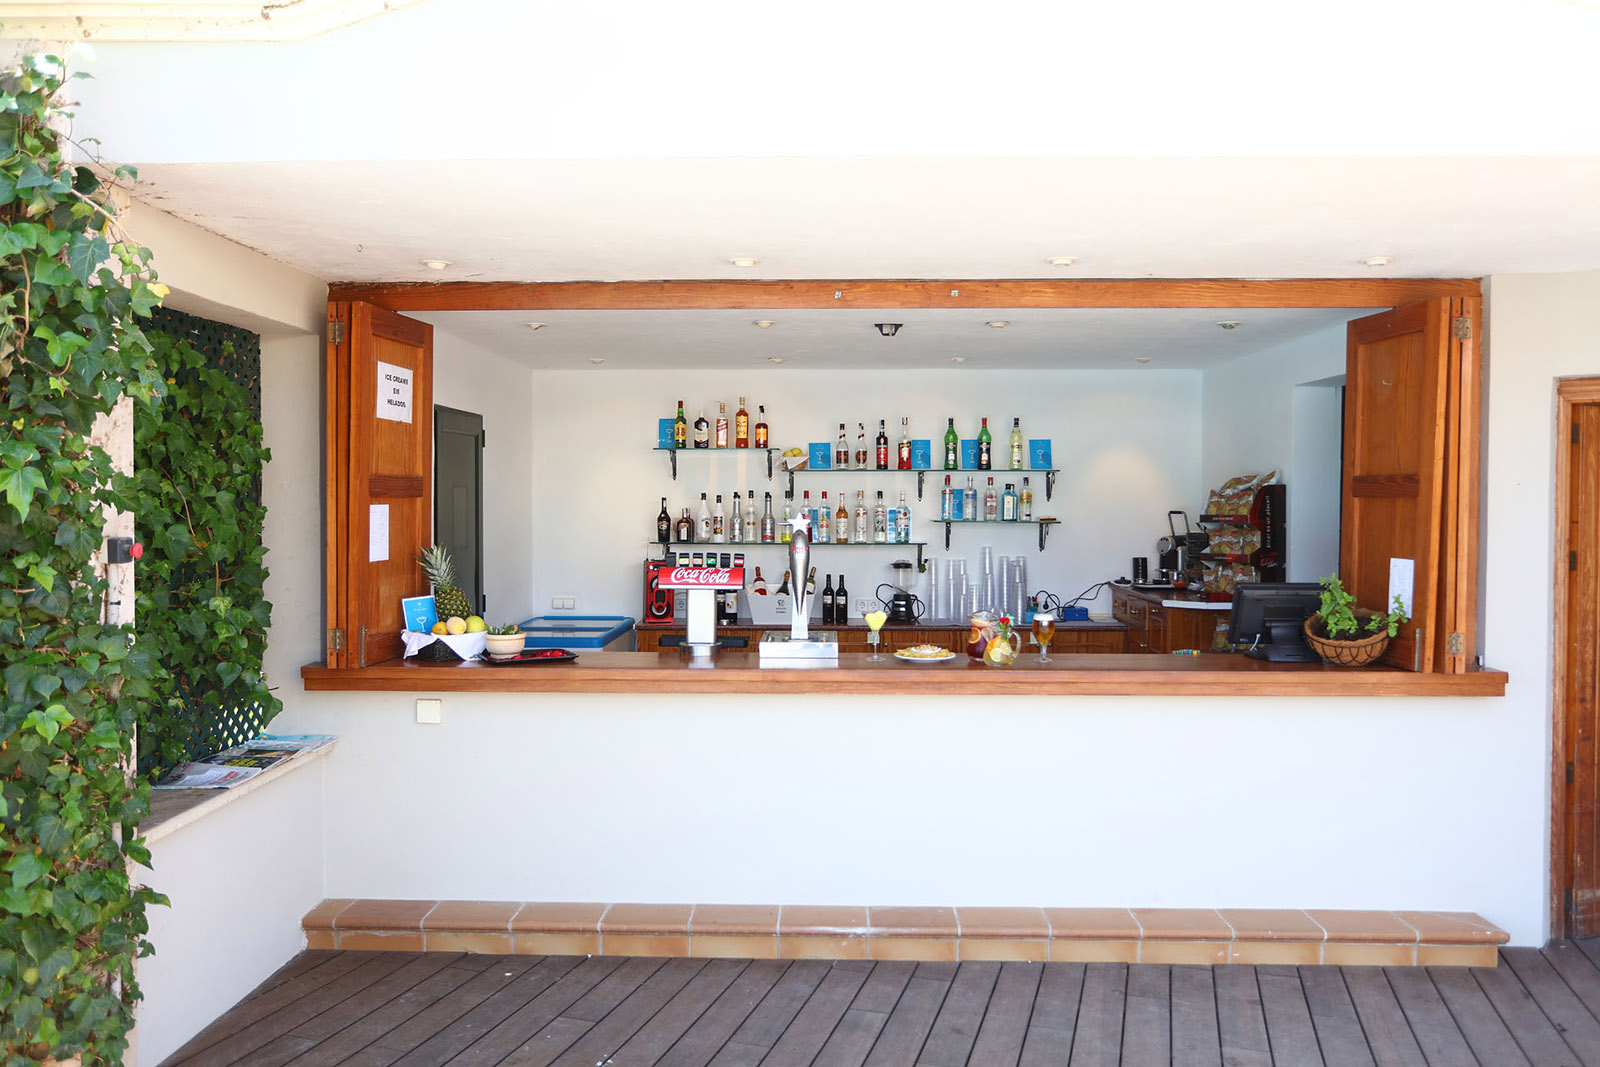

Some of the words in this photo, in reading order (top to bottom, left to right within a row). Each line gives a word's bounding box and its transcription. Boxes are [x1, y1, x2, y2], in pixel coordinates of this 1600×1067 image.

[393, 375, 408, 385] CREAMS
[387, 399, 406, 408] HELADOS
[671, 567, 731, 583] Coca-Cola
